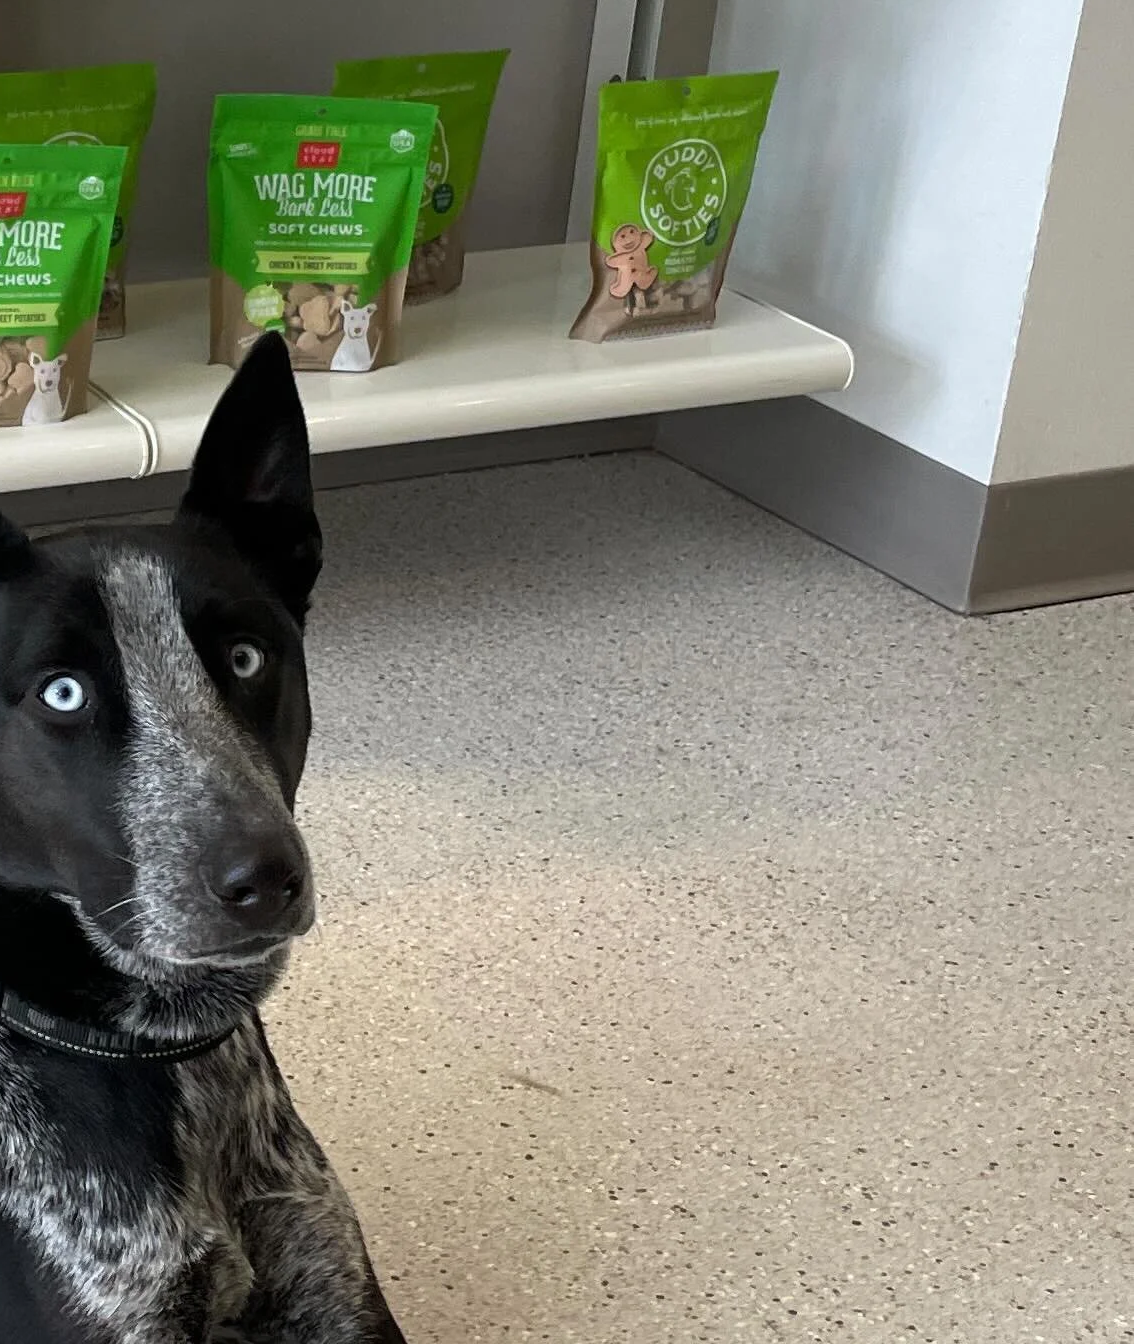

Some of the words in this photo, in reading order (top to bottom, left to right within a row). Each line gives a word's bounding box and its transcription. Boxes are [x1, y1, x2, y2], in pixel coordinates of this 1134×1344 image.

[653, 146, 715, 180] BUDDY
[254, 172, 305, 202] WAG
[313, 172, 376, 203] MORE
[276, 197, 315, 217] Bark
[319, 197, 353, 217] Less
[649, 193, 719, 237] SOFTIES
[269, 223, 305, 235] SOFT
[309, 223, 364, 236] CHEWS
[4, 245, 40, 267] Less
